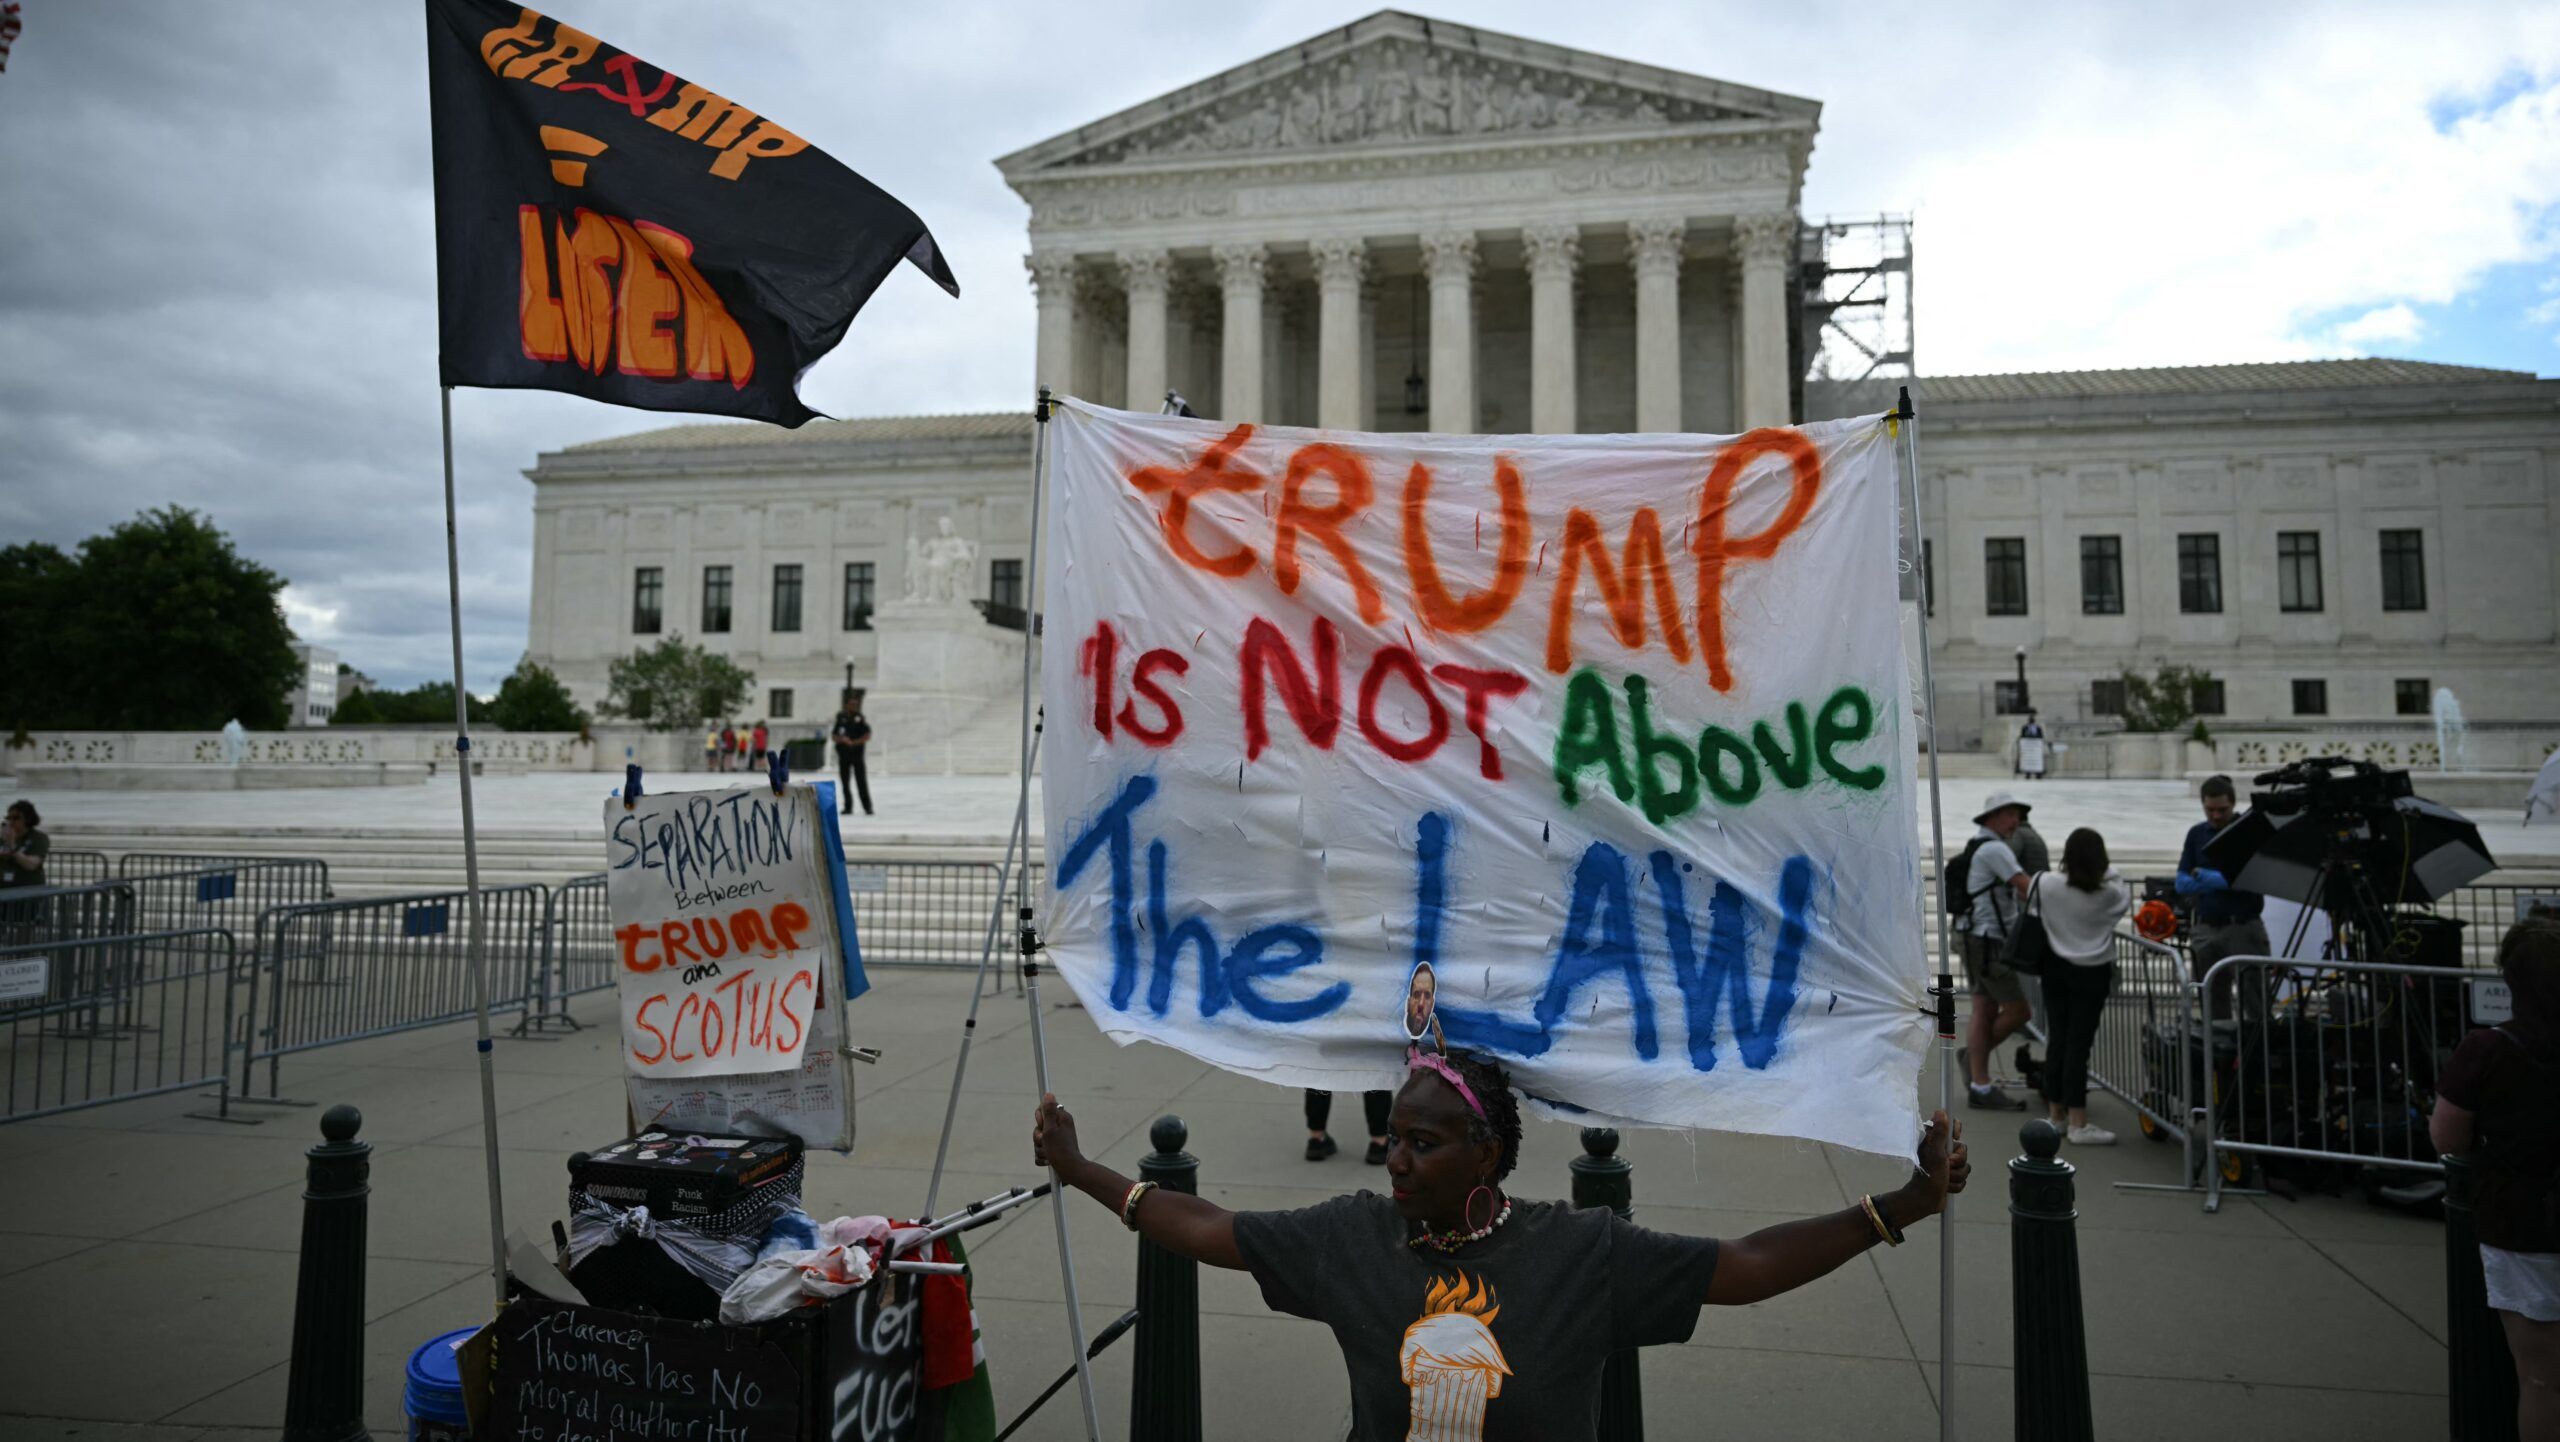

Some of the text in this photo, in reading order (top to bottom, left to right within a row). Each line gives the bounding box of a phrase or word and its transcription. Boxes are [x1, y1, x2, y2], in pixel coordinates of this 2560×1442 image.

[1238, 616, 1530, 781] NOT
[1554, 665, 1888, 826] Above
[613, 791, 796, 889] SEPARATION
[675, 877, 774, 911] Between
[1054, 774, 1815, 1072] The LAW
[683, 961, 722, 986] and
[631, 970, 812, 1066] SCOTUS
[586, 1183, 648, 1201] SOUNDBOKS
[671, 1201, 709, 1214] Racism
[677, 1187, 703, 1200] Fuck
[517, 1316, 636, 1386] Thomas
[644, 1342, 695, 1395] has
